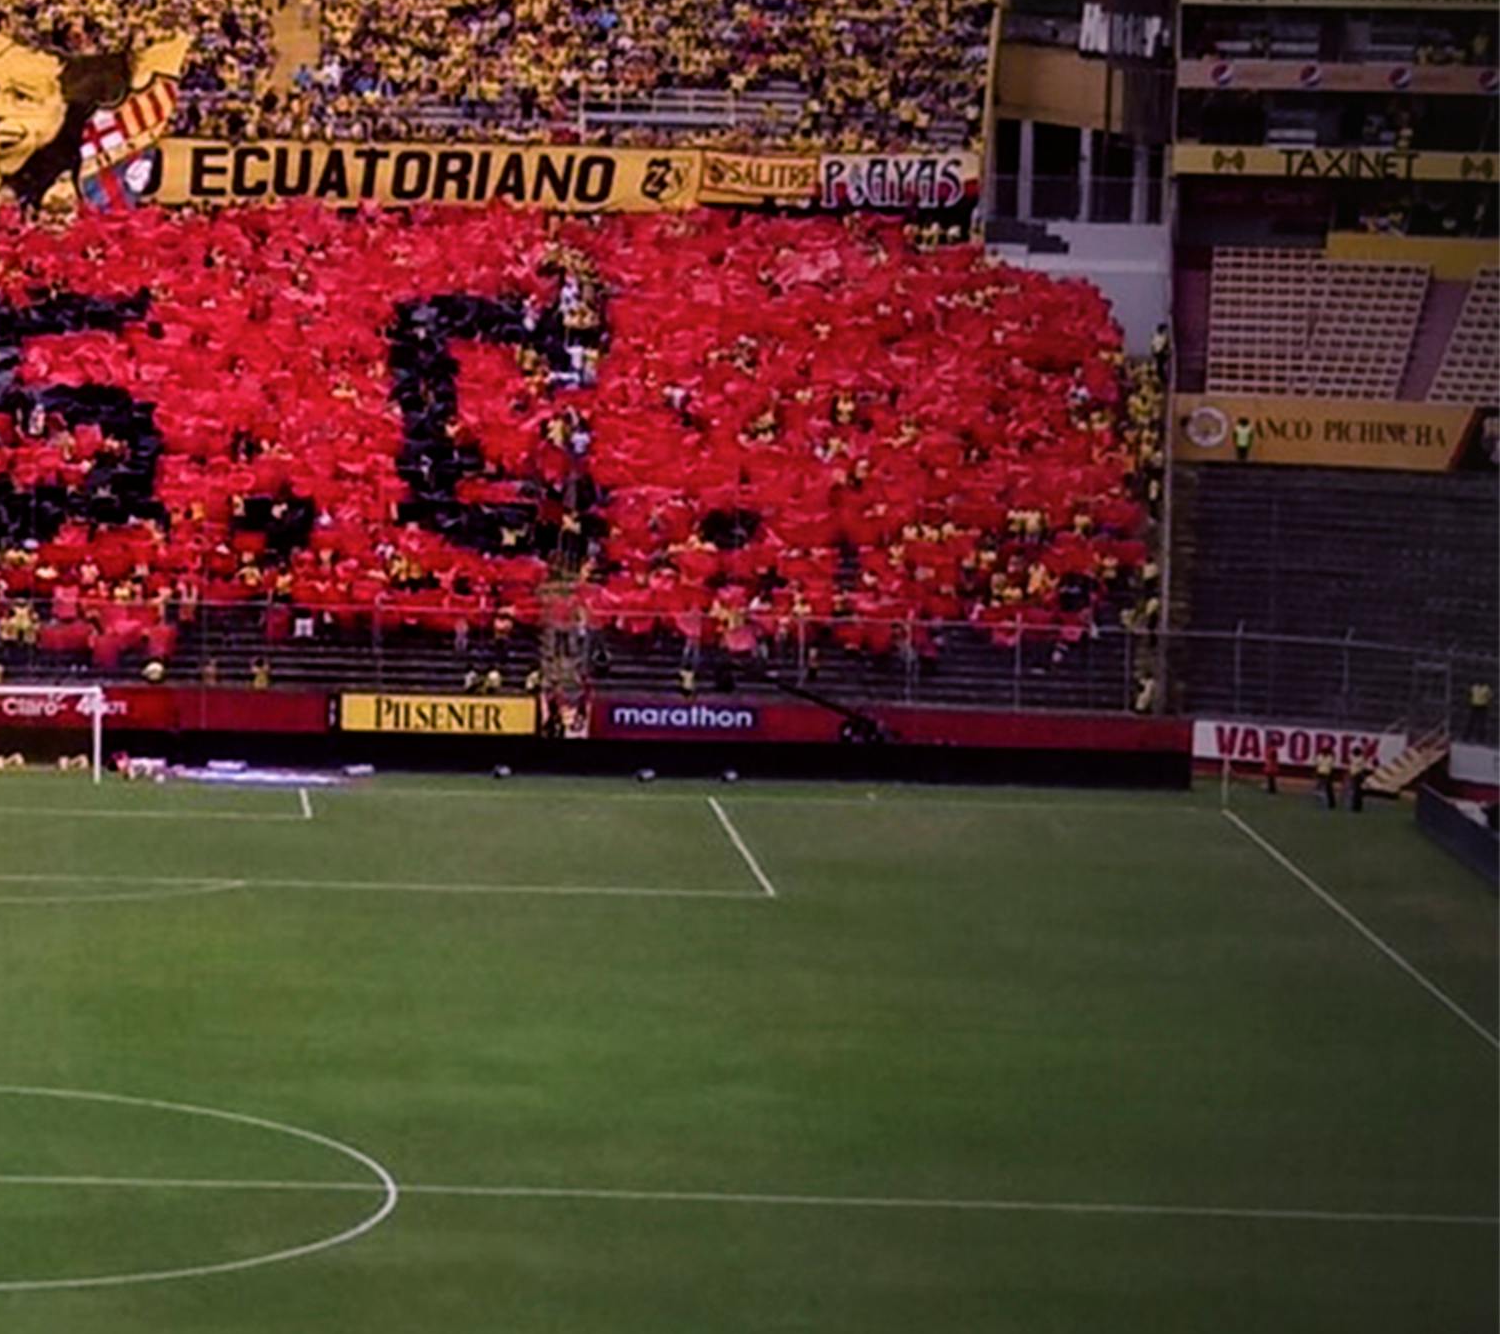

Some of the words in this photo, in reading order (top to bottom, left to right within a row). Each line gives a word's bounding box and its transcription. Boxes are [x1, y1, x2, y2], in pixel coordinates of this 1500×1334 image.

[191, 147, 617, 203] ECUATORIANO
[1243, 418, 1312, 441] ANCO
[2, 696, 57, 717] Claro
[374, 698, 503, 730] PILSENER
[613, 705, 754, 729] marathon
